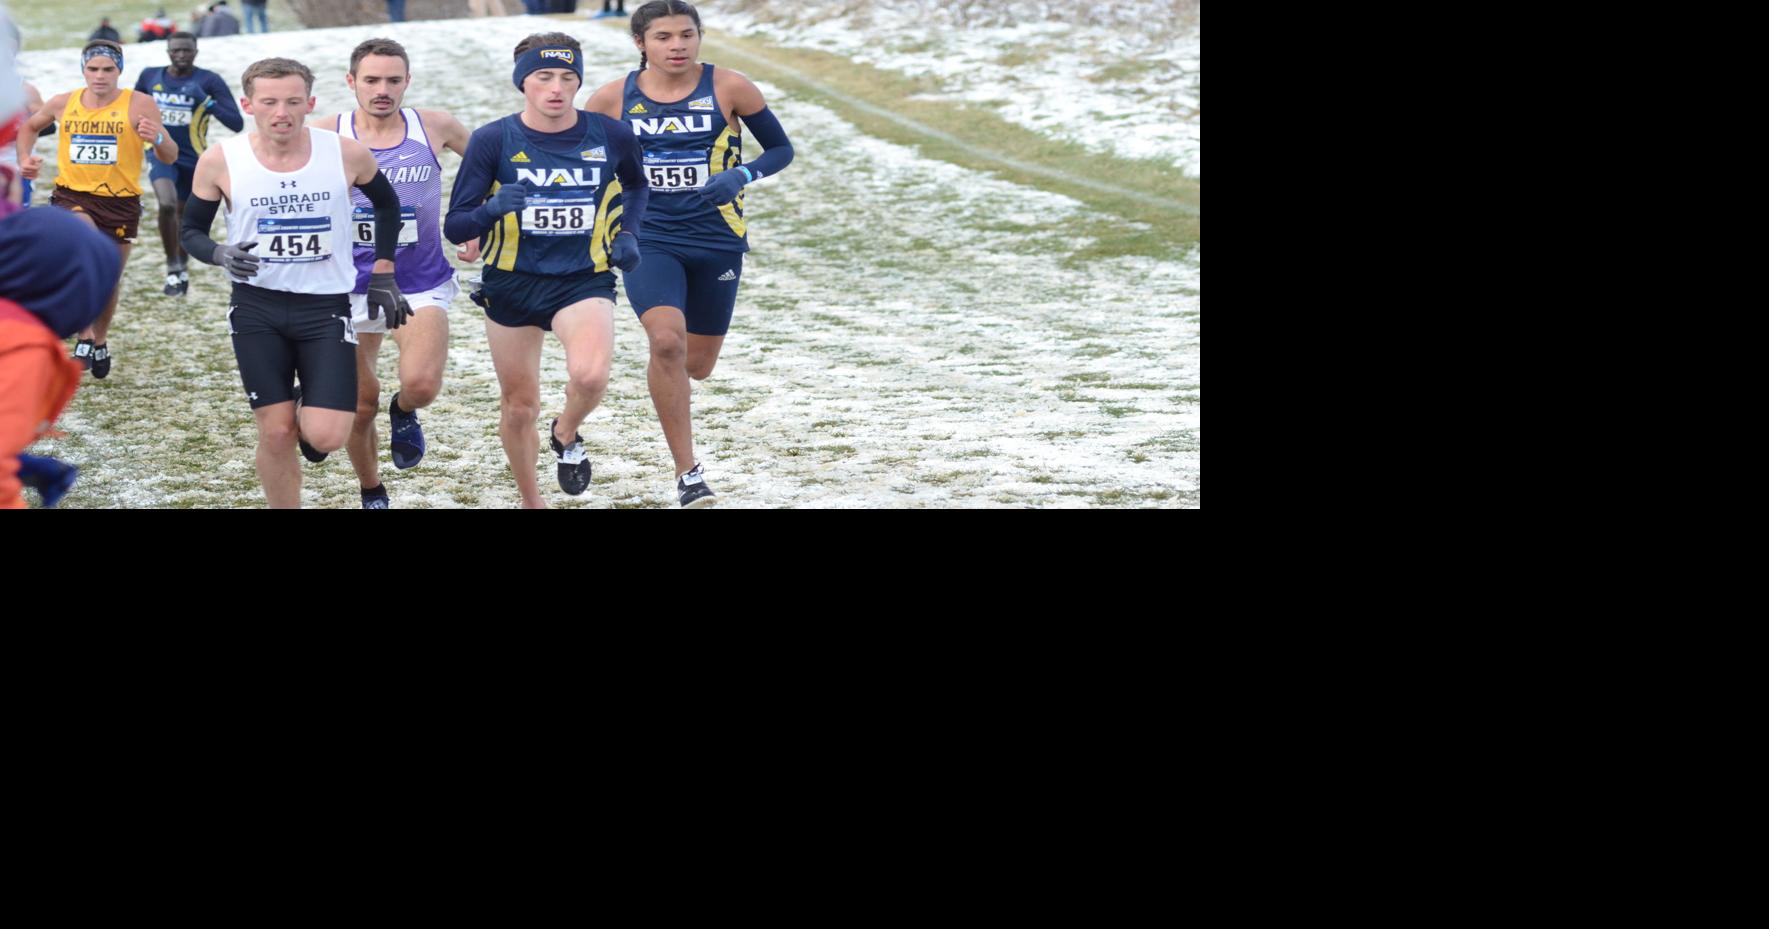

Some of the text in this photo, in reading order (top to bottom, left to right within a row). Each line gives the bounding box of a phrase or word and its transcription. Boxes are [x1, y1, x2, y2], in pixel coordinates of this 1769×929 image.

[544, 51, 571, 59] NAU
[152, 91, 195, 105] NAU
[64, 120, 124, 134] WYOMING
[630, 114, 712, 136] NAU
[75, 145, 110, 161] 735
[380, 165, 432, 184] LAND
[516, 167, 601, 187] NAU
[649, 166, 698, 187] 559
[250, 191, 331, 207] COLORADO
[268, 203, 315, 215] STATE
[534, 207, 584, 229] 558
[357, 222, 405, 242] 67
[269, 234, 322, 257] 454
